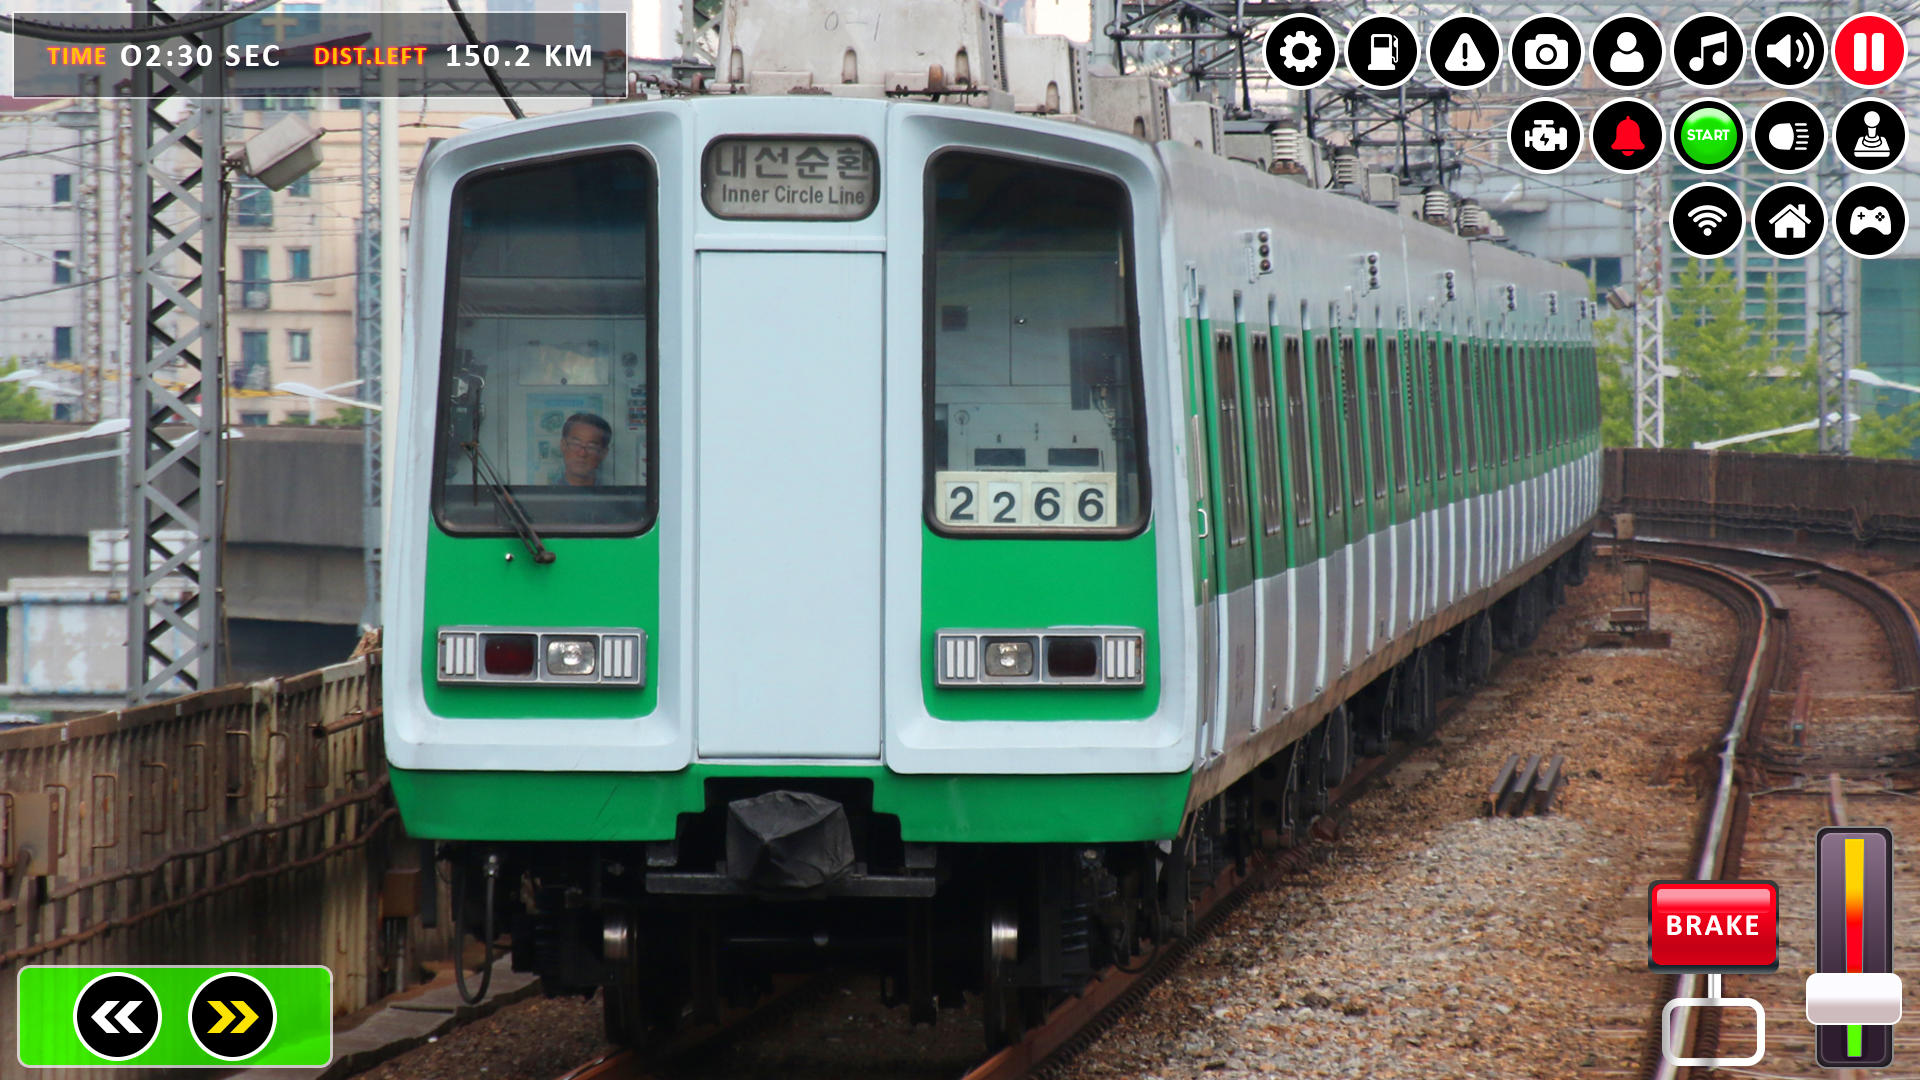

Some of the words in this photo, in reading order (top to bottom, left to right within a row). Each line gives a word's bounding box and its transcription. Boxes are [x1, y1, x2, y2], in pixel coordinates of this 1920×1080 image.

[715, 144, 870, 180] 내선순환
[722, 184, 769, 203] Inner
[775, 185, 823, 204] Circle
[828, 186, 865, 205] Line
[949, 485, 1104, 523] 2266
